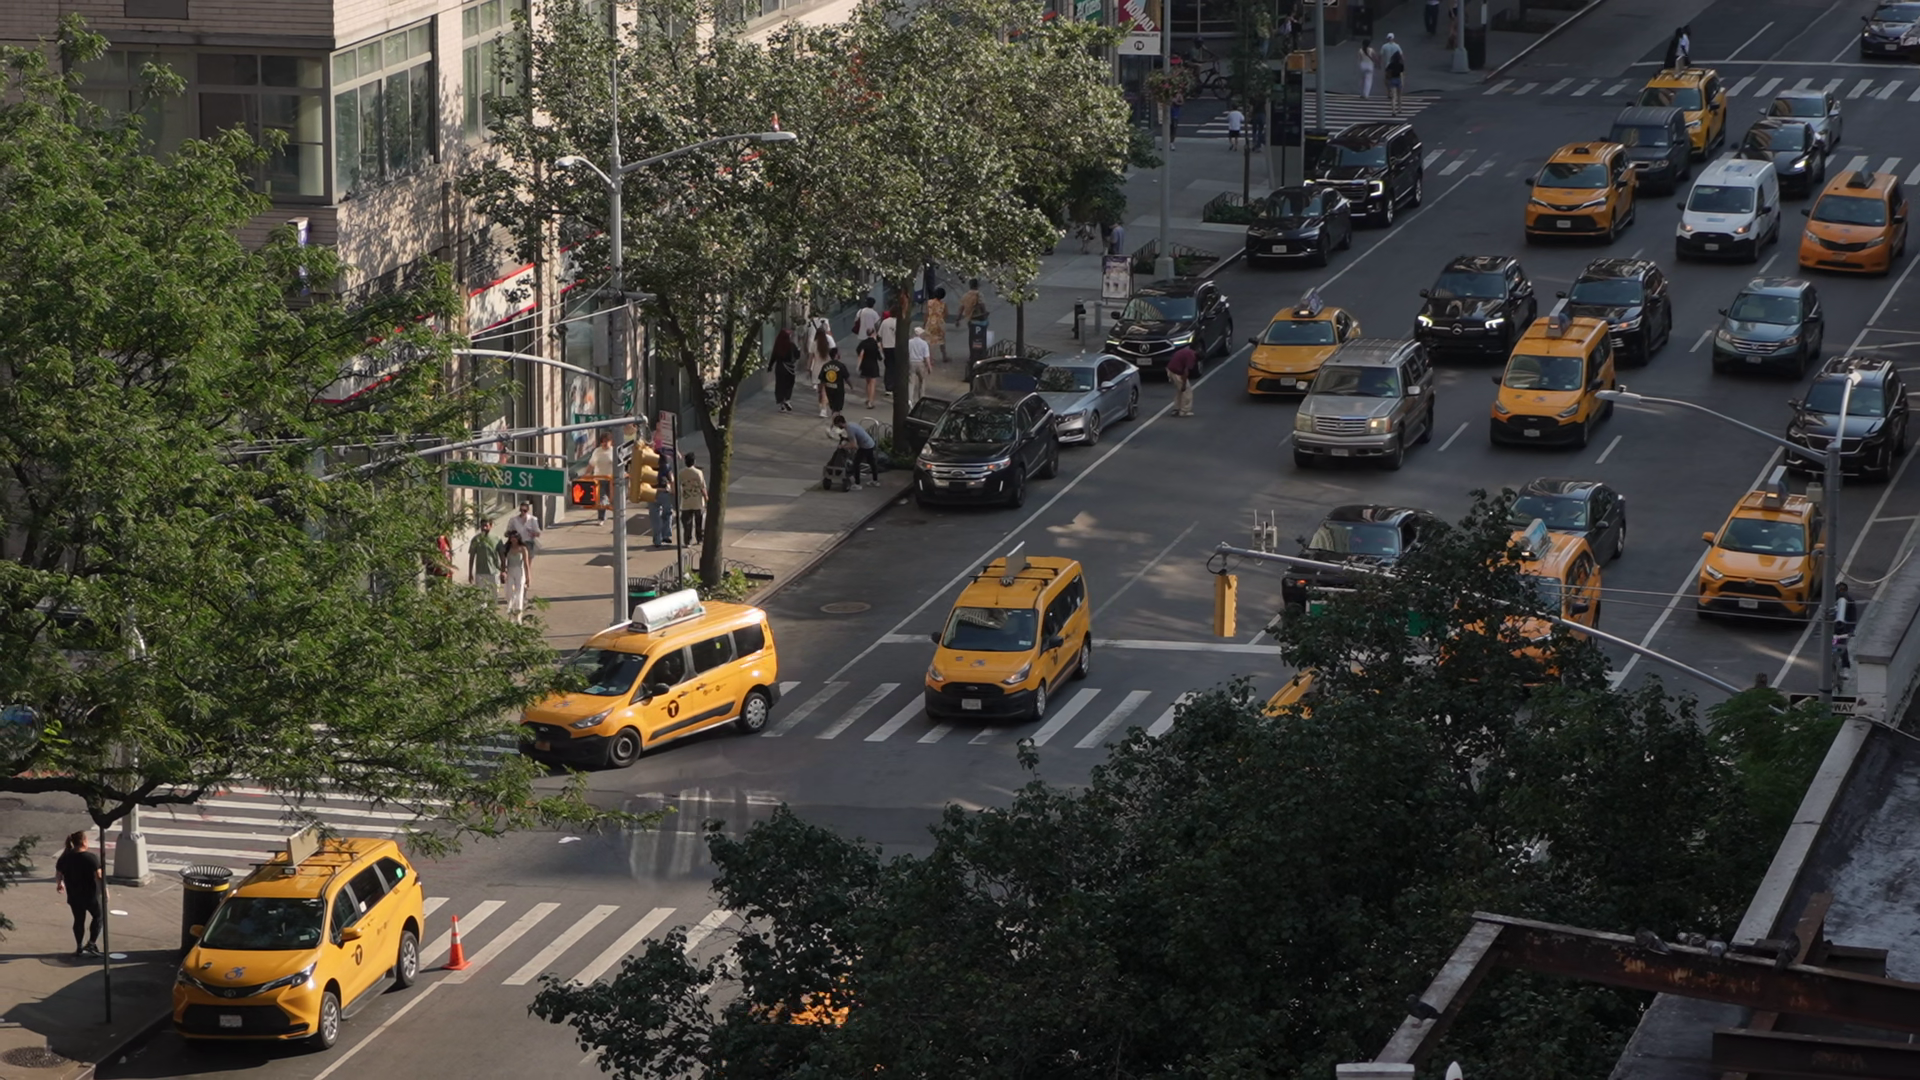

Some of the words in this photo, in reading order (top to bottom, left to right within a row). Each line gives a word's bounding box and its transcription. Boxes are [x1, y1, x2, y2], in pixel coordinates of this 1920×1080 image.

[1123, 0, 1155, 32] NOMAD
[975, 326, 981, 334] P
[518, 471, 534, 488] St
[1833, 703, 1854, 712] WAY
